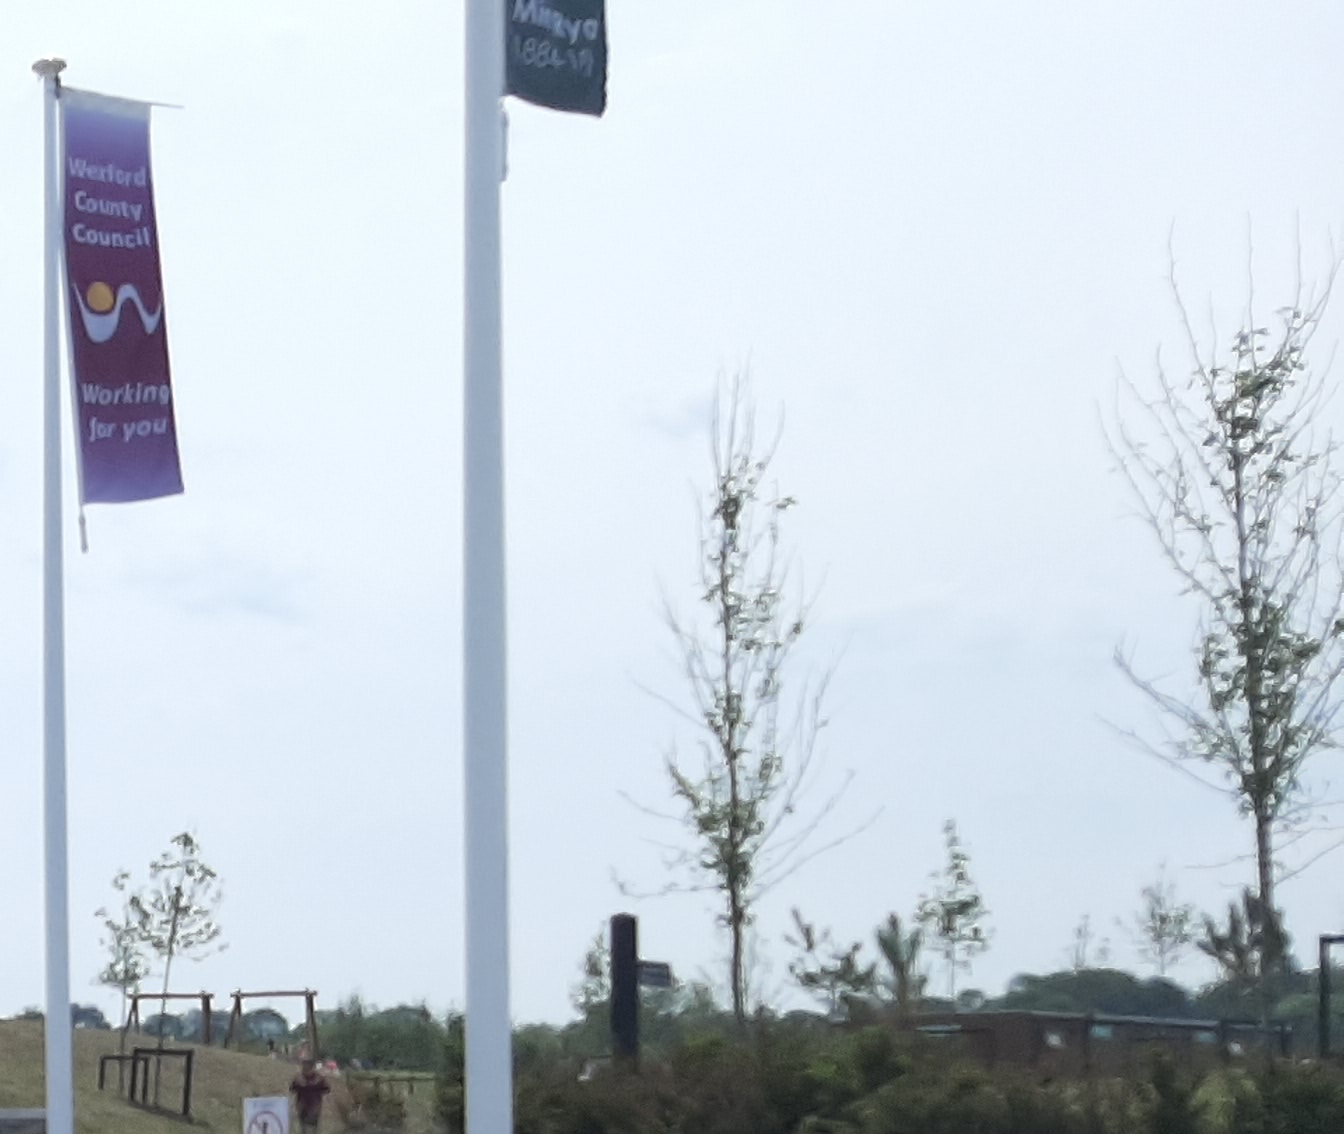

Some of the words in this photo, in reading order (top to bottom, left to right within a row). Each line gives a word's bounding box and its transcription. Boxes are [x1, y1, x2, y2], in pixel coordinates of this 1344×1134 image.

[69, 157, 147, 186] Wexford
[74, 190, 144, 222] County
[72, 223, 152, 249] Council
[81, 383, 170, 405] Working
[89, 417, 117, 443] for
[122, 418, 167, 443] you
